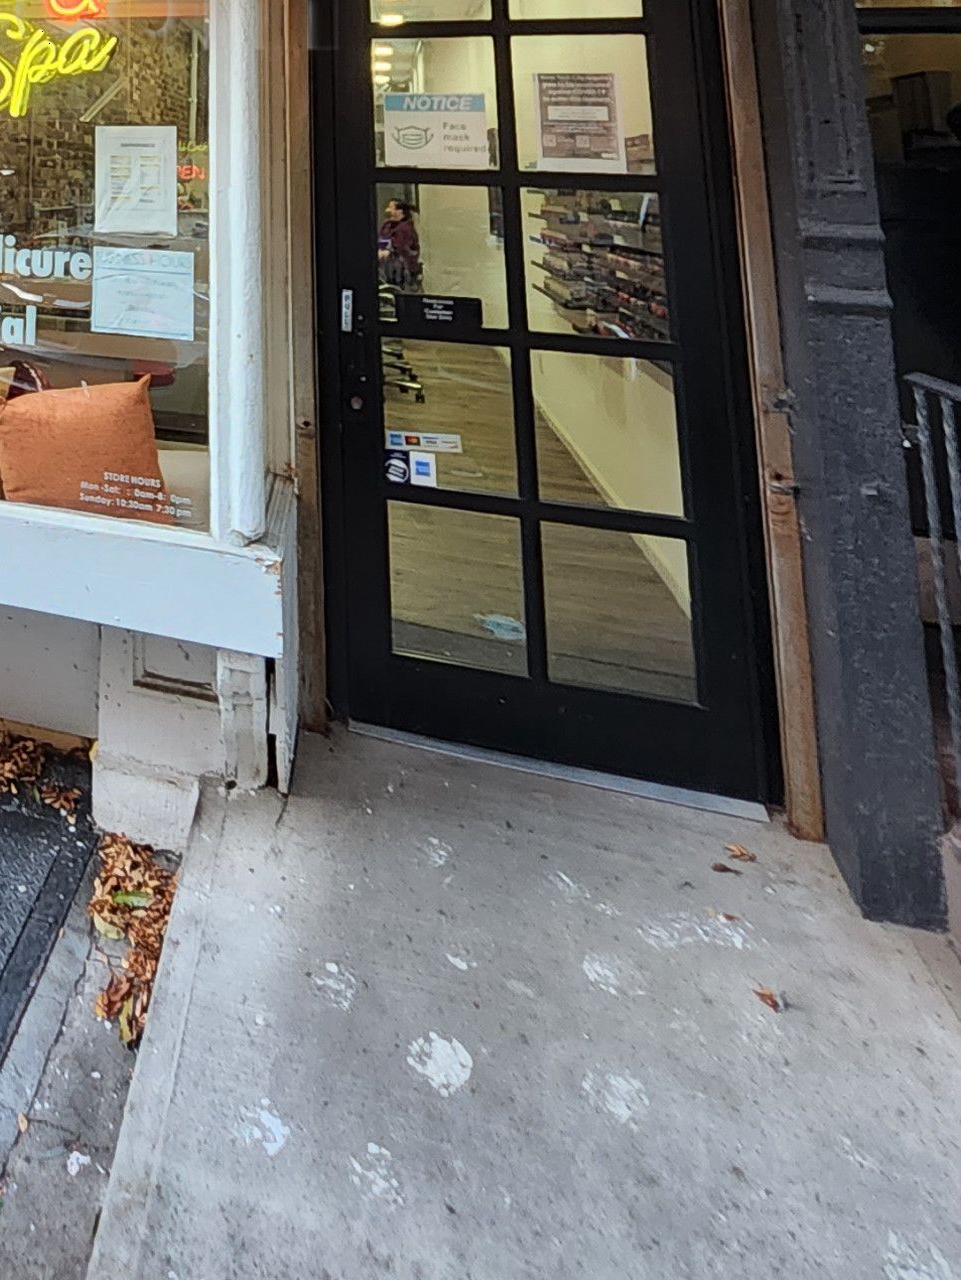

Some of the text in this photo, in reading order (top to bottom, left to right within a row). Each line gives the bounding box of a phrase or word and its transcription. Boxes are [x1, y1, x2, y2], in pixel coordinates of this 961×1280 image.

[403, 95, 473, 111] NOTICE
[442, 122, 467, 130] Face
[443, 133, 470, 141] mask
[443, 144, 487, 154] required
[104, 471, 161, 488] STORE HOURS
